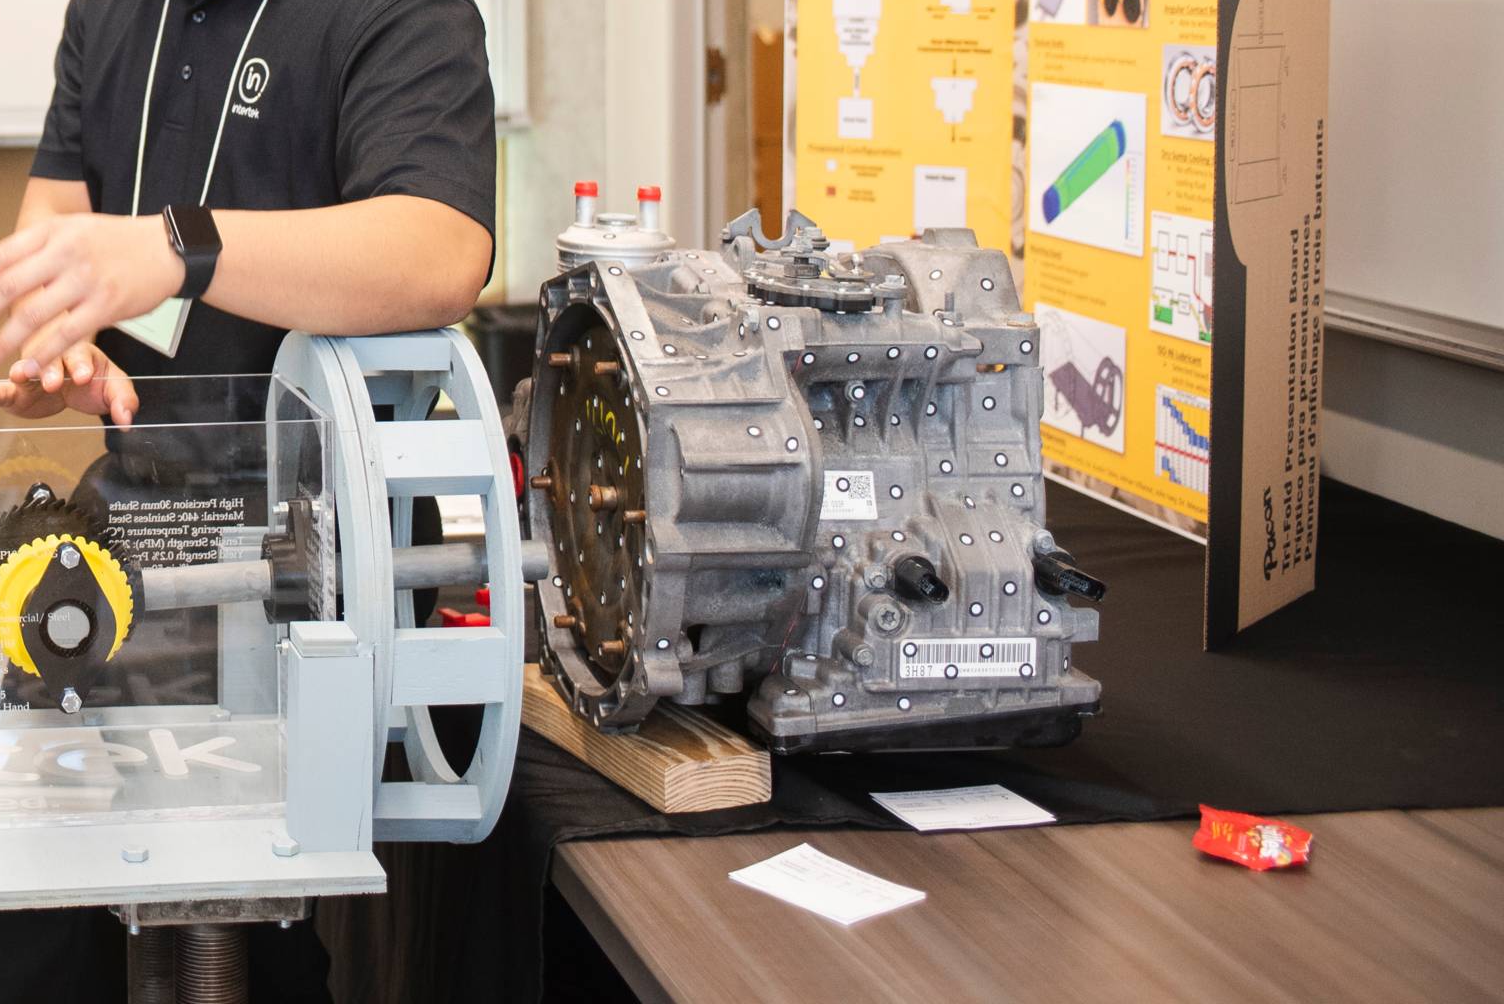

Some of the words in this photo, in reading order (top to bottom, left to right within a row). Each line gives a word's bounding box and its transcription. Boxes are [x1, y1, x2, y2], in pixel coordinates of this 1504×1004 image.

[1313, 118, 1324, 221] battants
[1289, 228, 1299, 304] Board
[1313, 228, 1322, 286] trois
[1299, 213, 1311, 403] presentaciones
[1284, 311, 1299, 473] Presentation
[1308, 316, 1321, 448] d'affichage
[1297, 411, 1307, 466] para
[1263, 485, 1278, 581] Pacon
[1281, 480, 1294, 575] Tri-Fold
[1304, 456, 1316, 563] Panneau
[47, 612, 71, 622] Steel
[3, 702, 30, 713] Hand
[905, 665, 933, 677] 3H87
